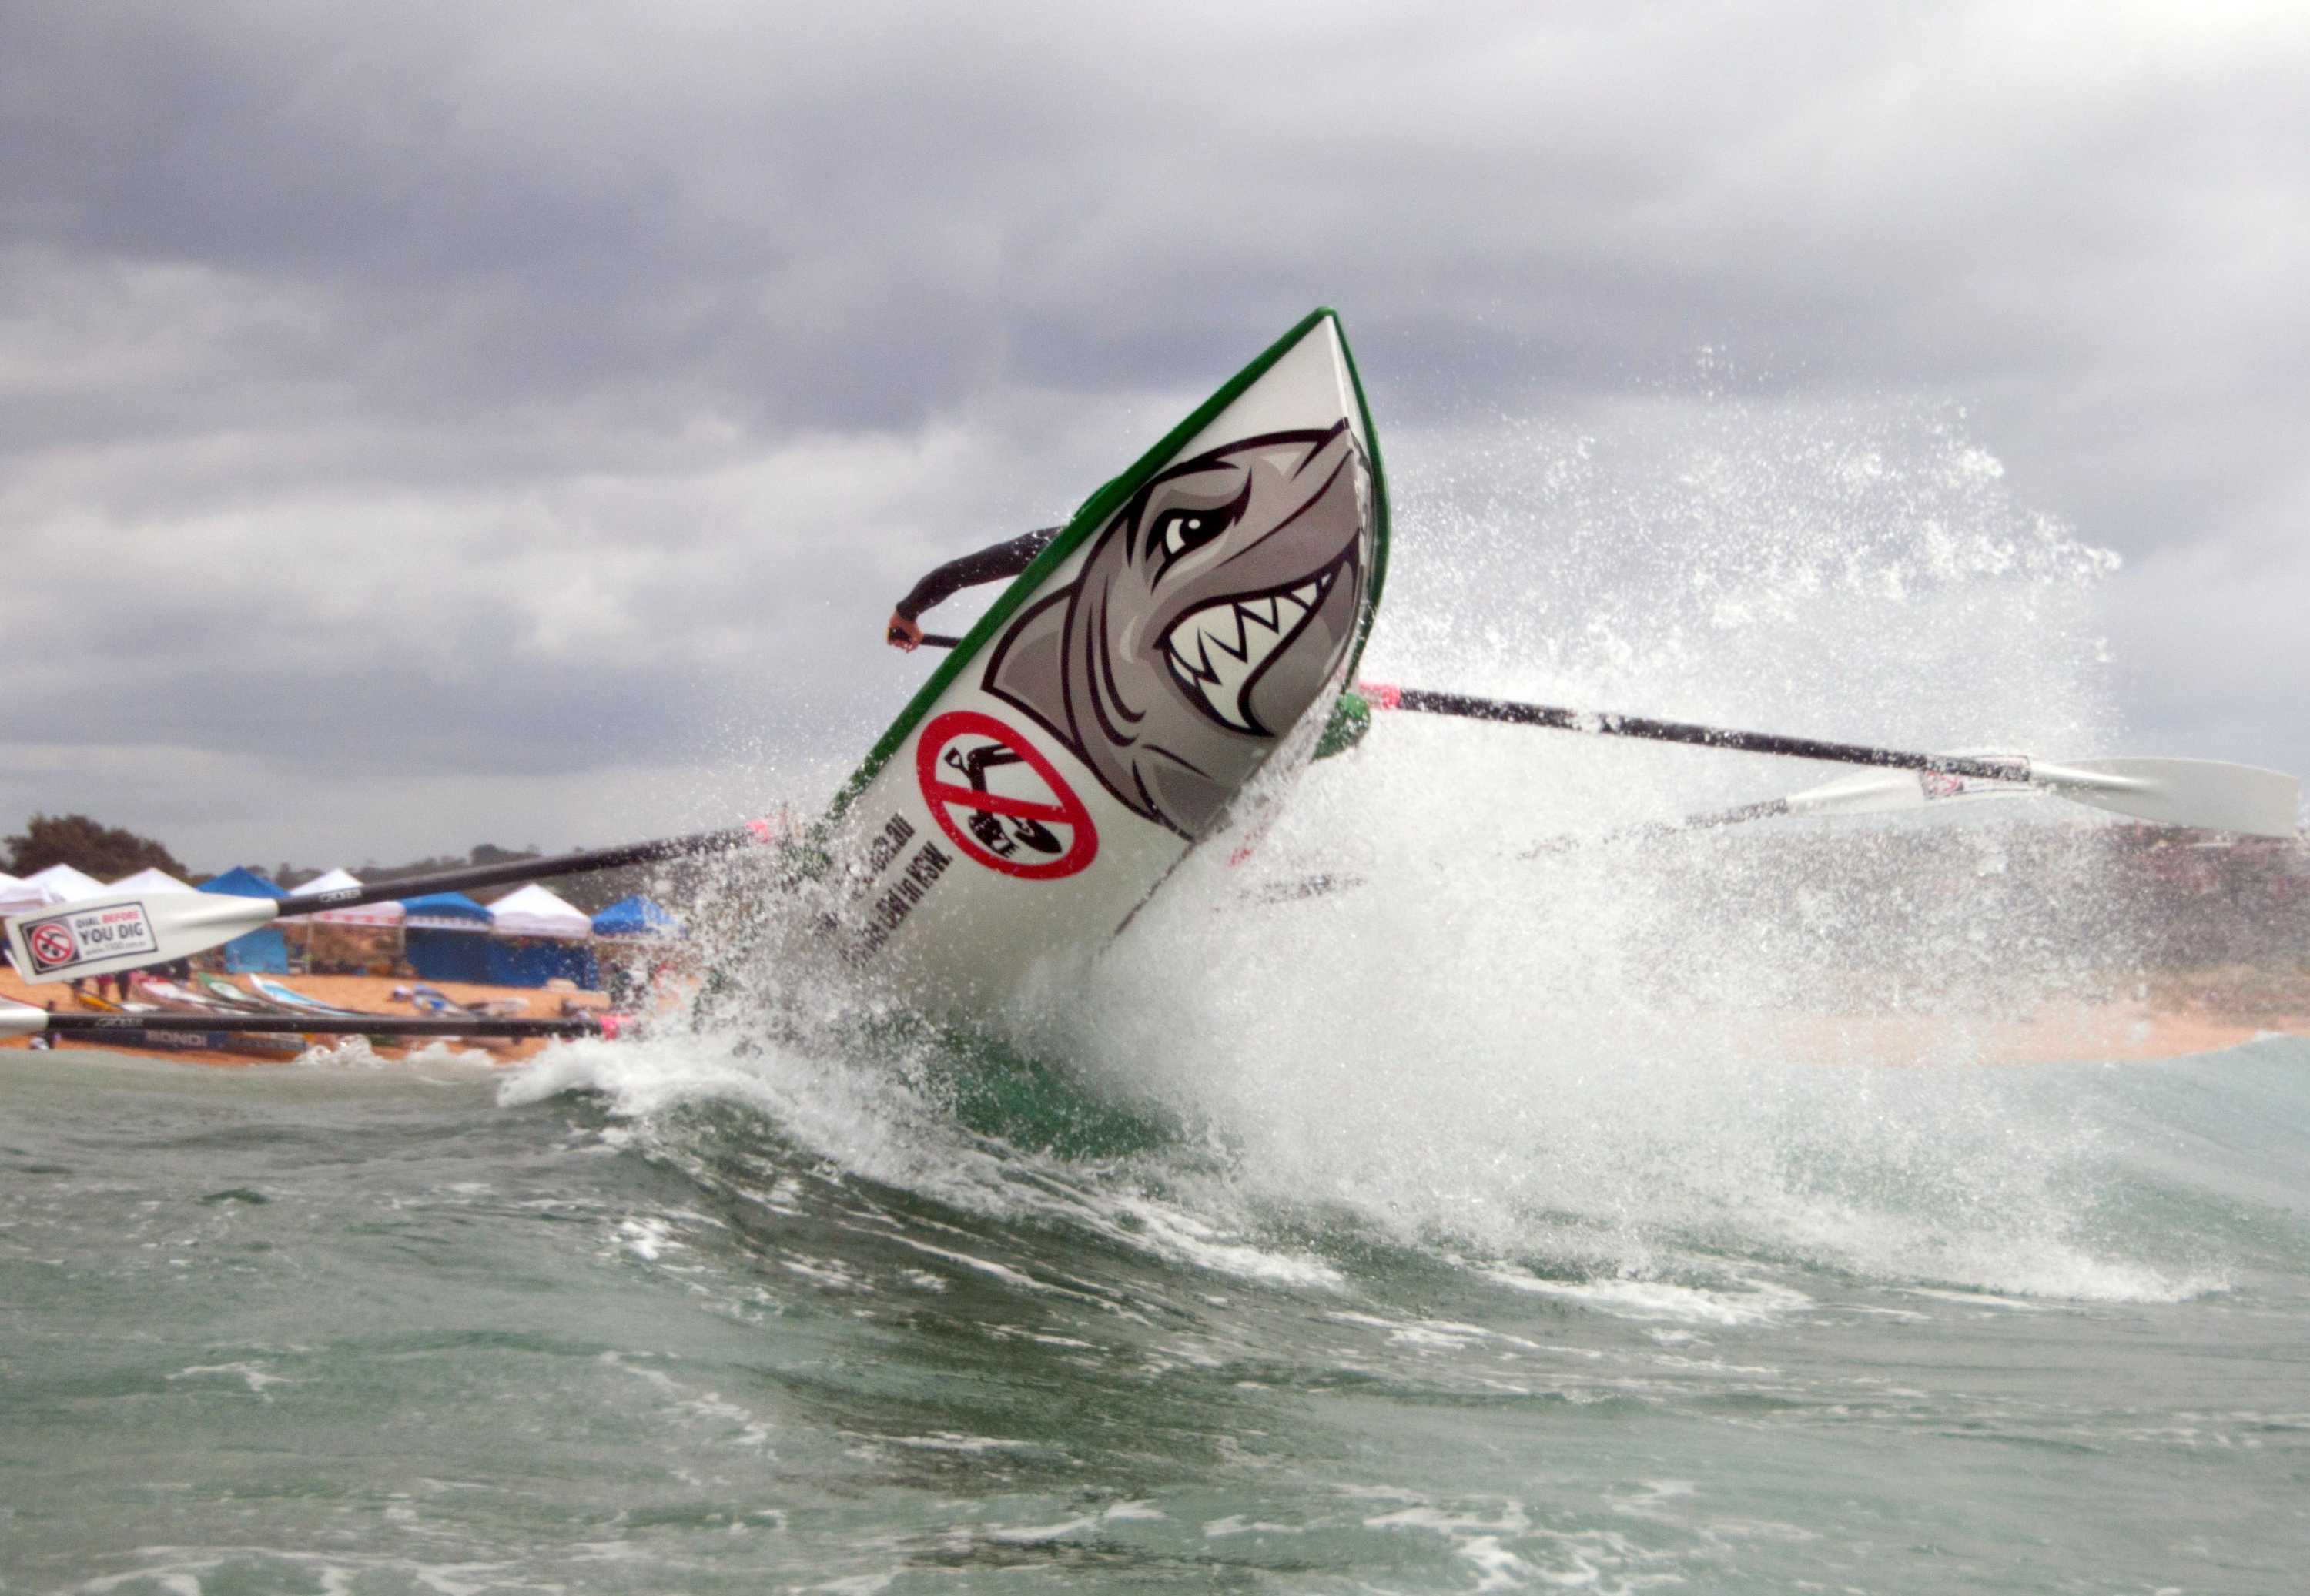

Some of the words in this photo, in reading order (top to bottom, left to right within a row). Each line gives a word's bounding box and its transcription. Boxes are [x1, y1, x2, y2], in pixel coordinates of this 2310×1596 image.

[893, 878, 925, 905] in
[79, 925, 113, 945] YOU
[118, 922, 144, 939] DIG
